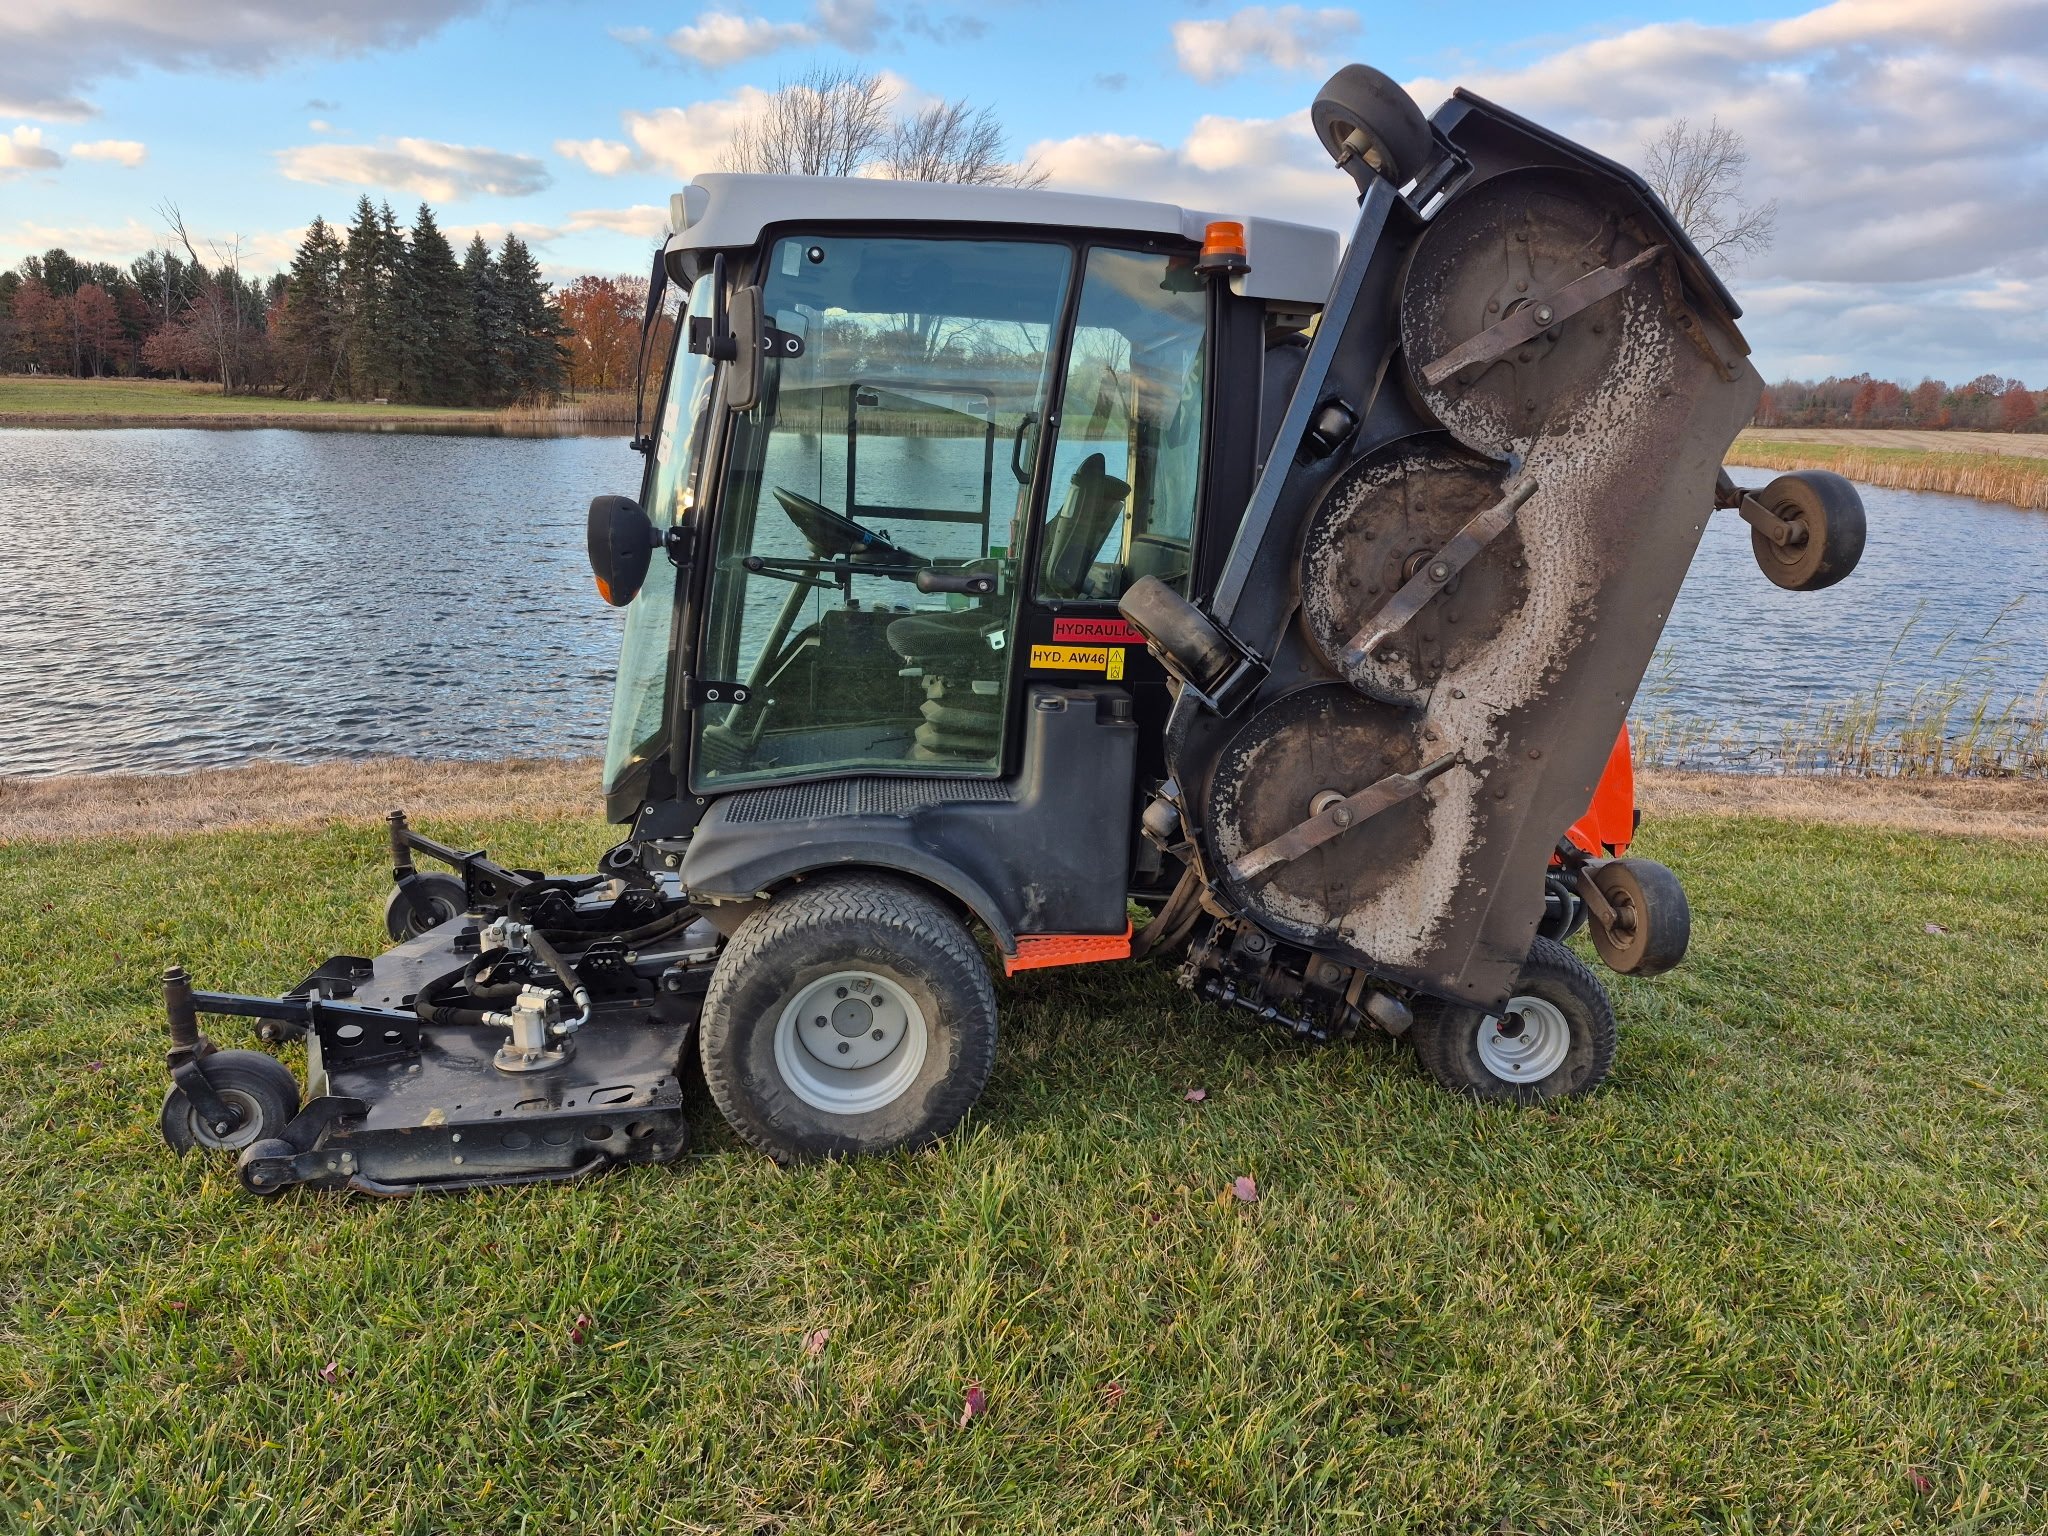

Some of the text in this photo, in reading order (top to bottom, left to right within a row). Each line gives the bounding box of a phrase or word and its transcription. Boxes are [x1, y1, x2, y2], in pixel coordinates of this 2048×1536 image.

[1056, 624, 1135, 637] HYDRAULIC
[1033, 651, 1105, 665] HYD. AW46
